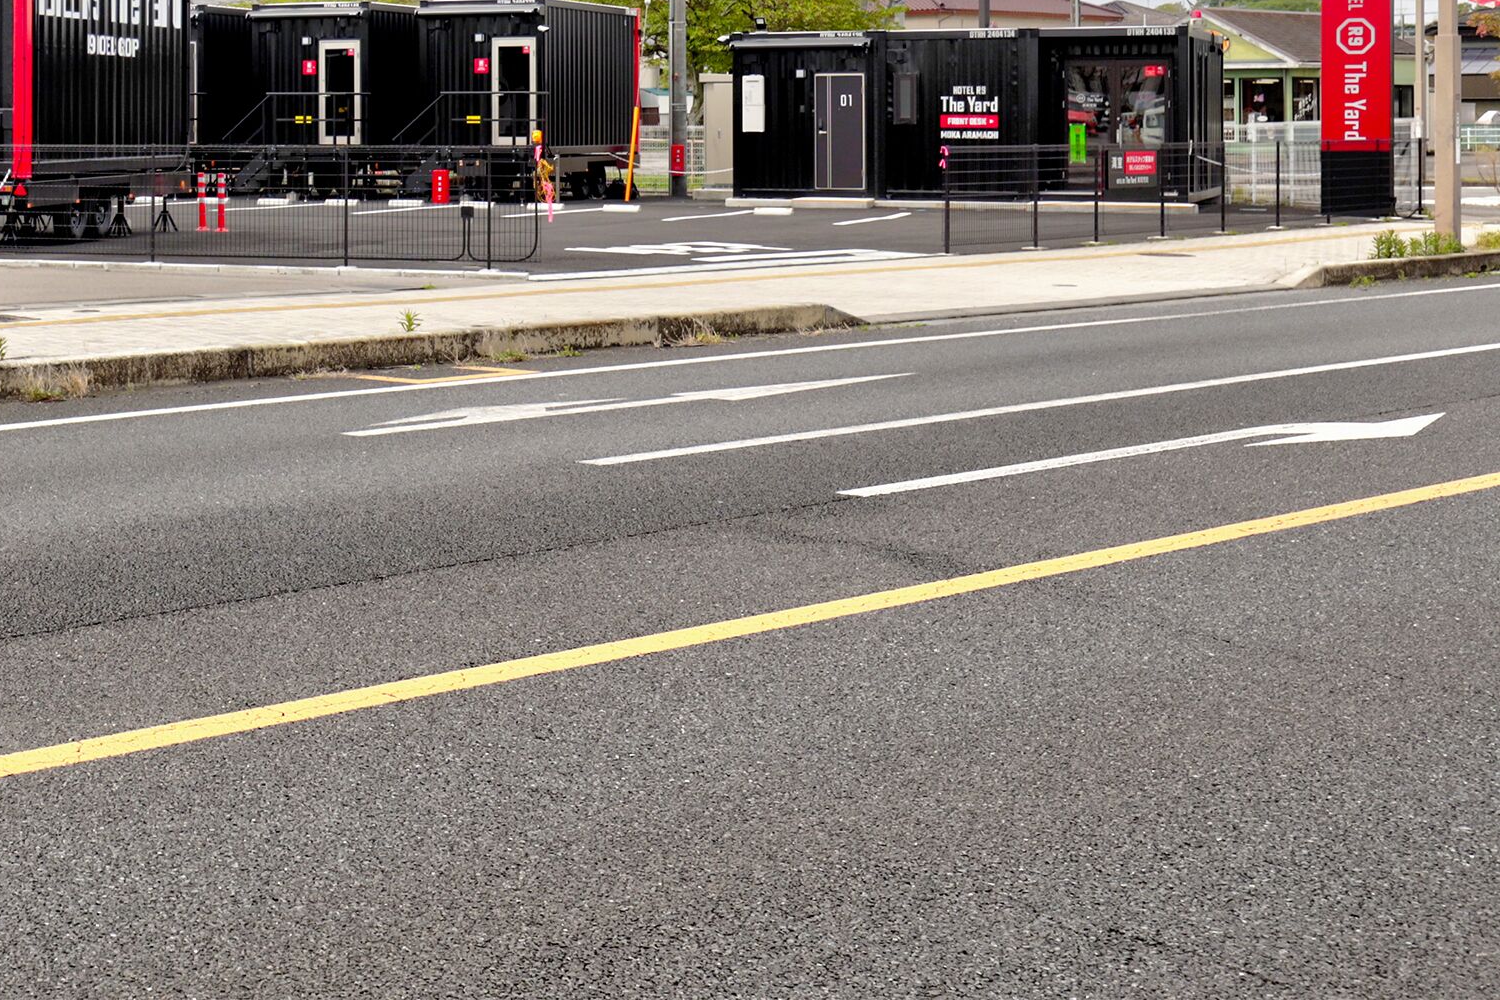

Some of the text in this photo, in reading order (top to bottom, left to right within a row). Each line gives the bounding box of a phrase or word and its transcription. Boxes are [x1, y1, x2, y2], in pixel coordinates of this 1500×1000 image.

[1347, 26, 1364, 47] R9
[1343, 60, 1368, 95] The
[952, 85, 975, 95] HOTEL
[840, 94, 853, 107] 01
[940, 96, 999, 112] The Yard
[1343, 99, 1368, 142] Yard
[940, 130, 999, 140] MOKA ARAMACHI
